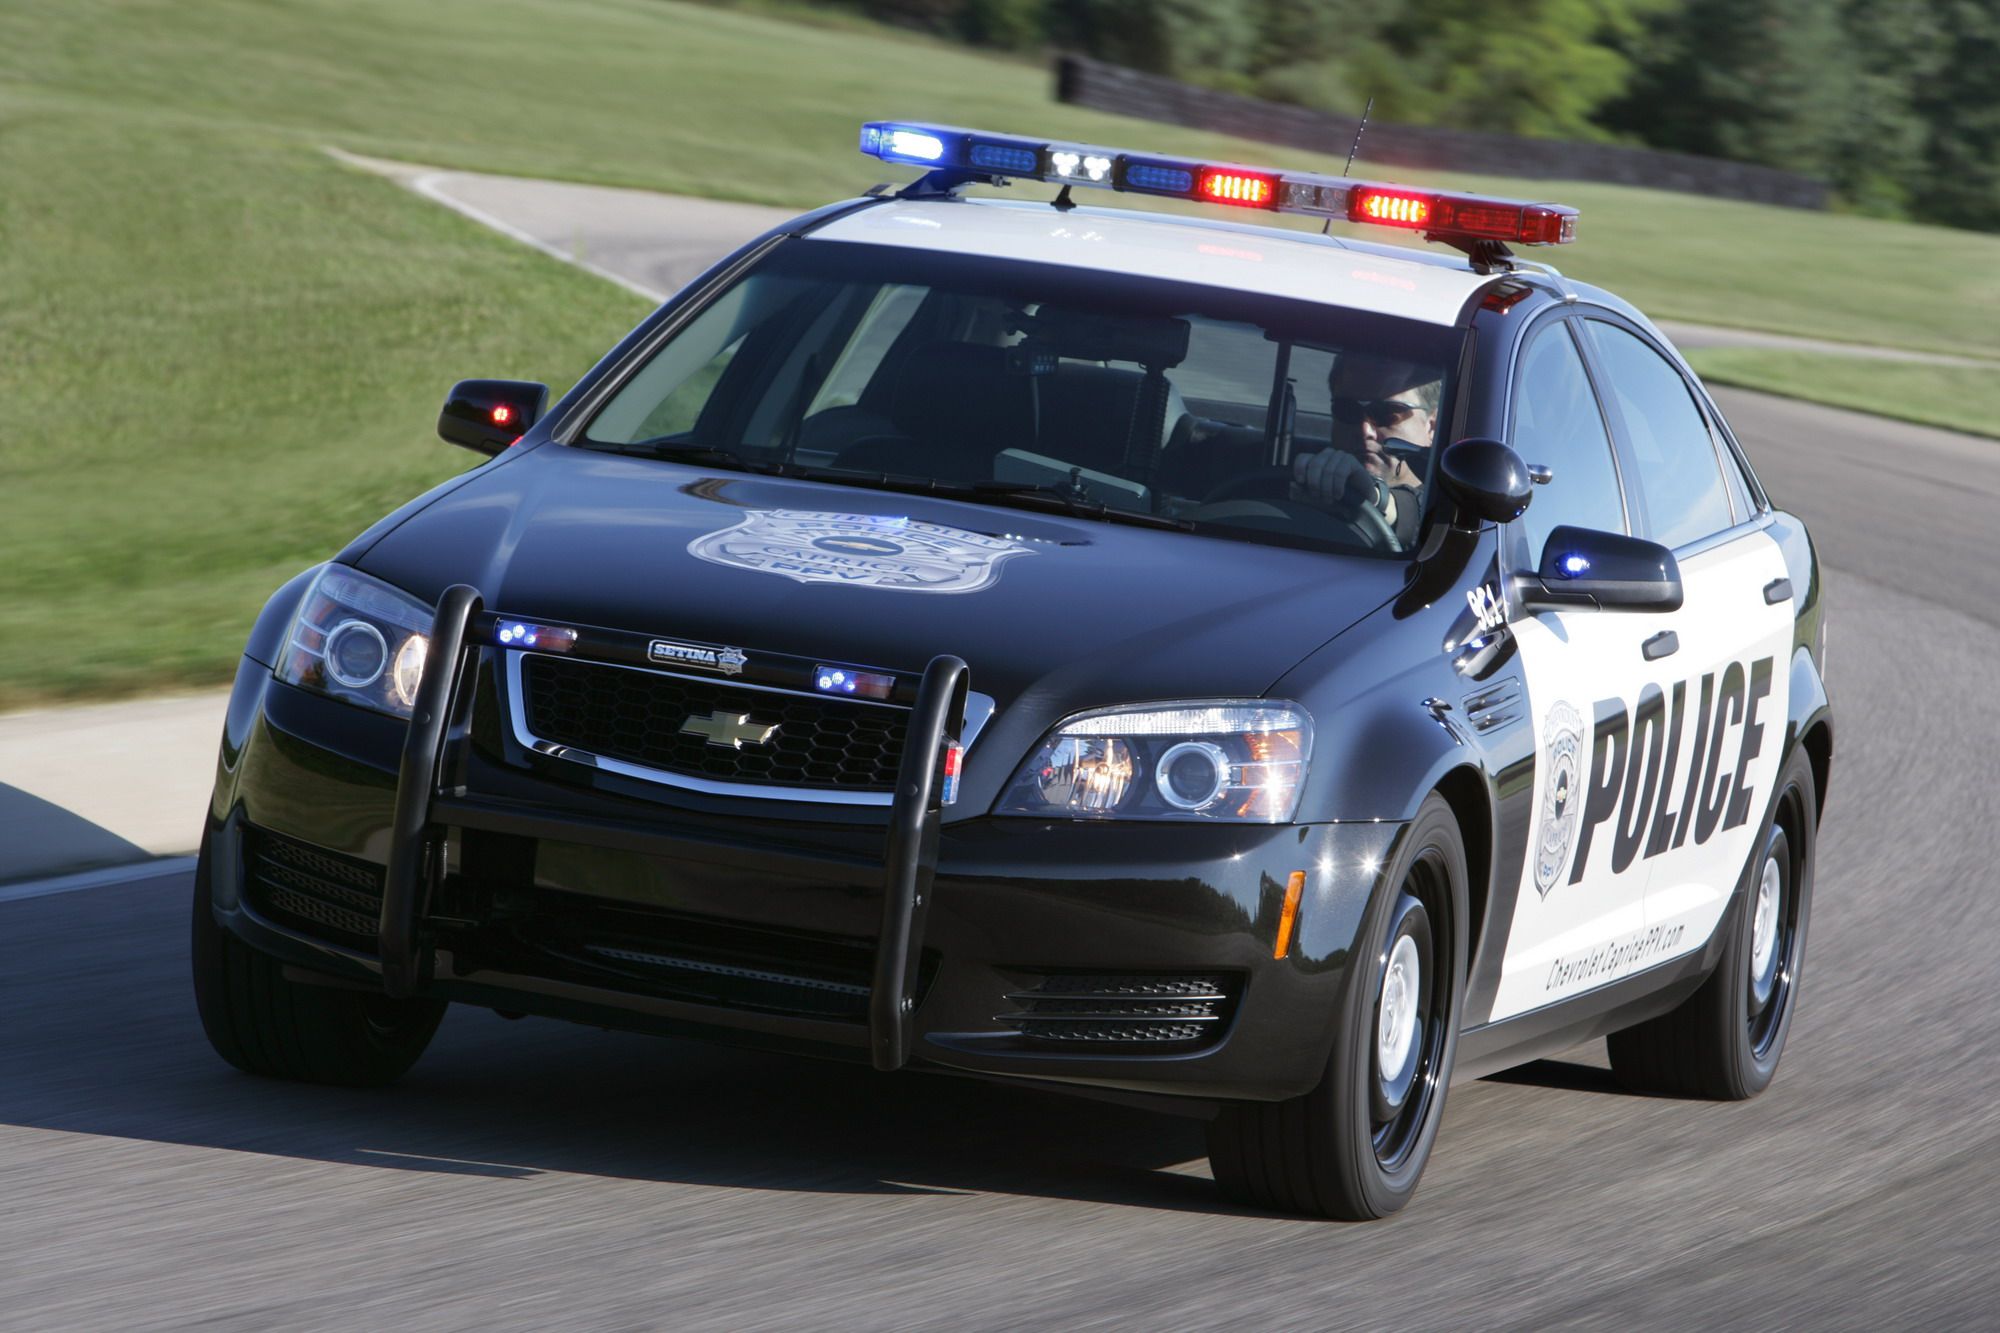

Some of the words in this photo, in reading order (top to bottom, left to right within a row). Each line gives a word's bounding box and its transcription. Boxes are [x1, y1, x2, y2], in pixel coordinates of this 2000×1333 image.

[797, 522, 962, 549] POLICE
[761, 545, 921, 574] CAPRICE
[770, 561, 872, 581] PPV
[653, 643, 716, 662] SETINA
[1567, 655, 1774, 886] POLICE
